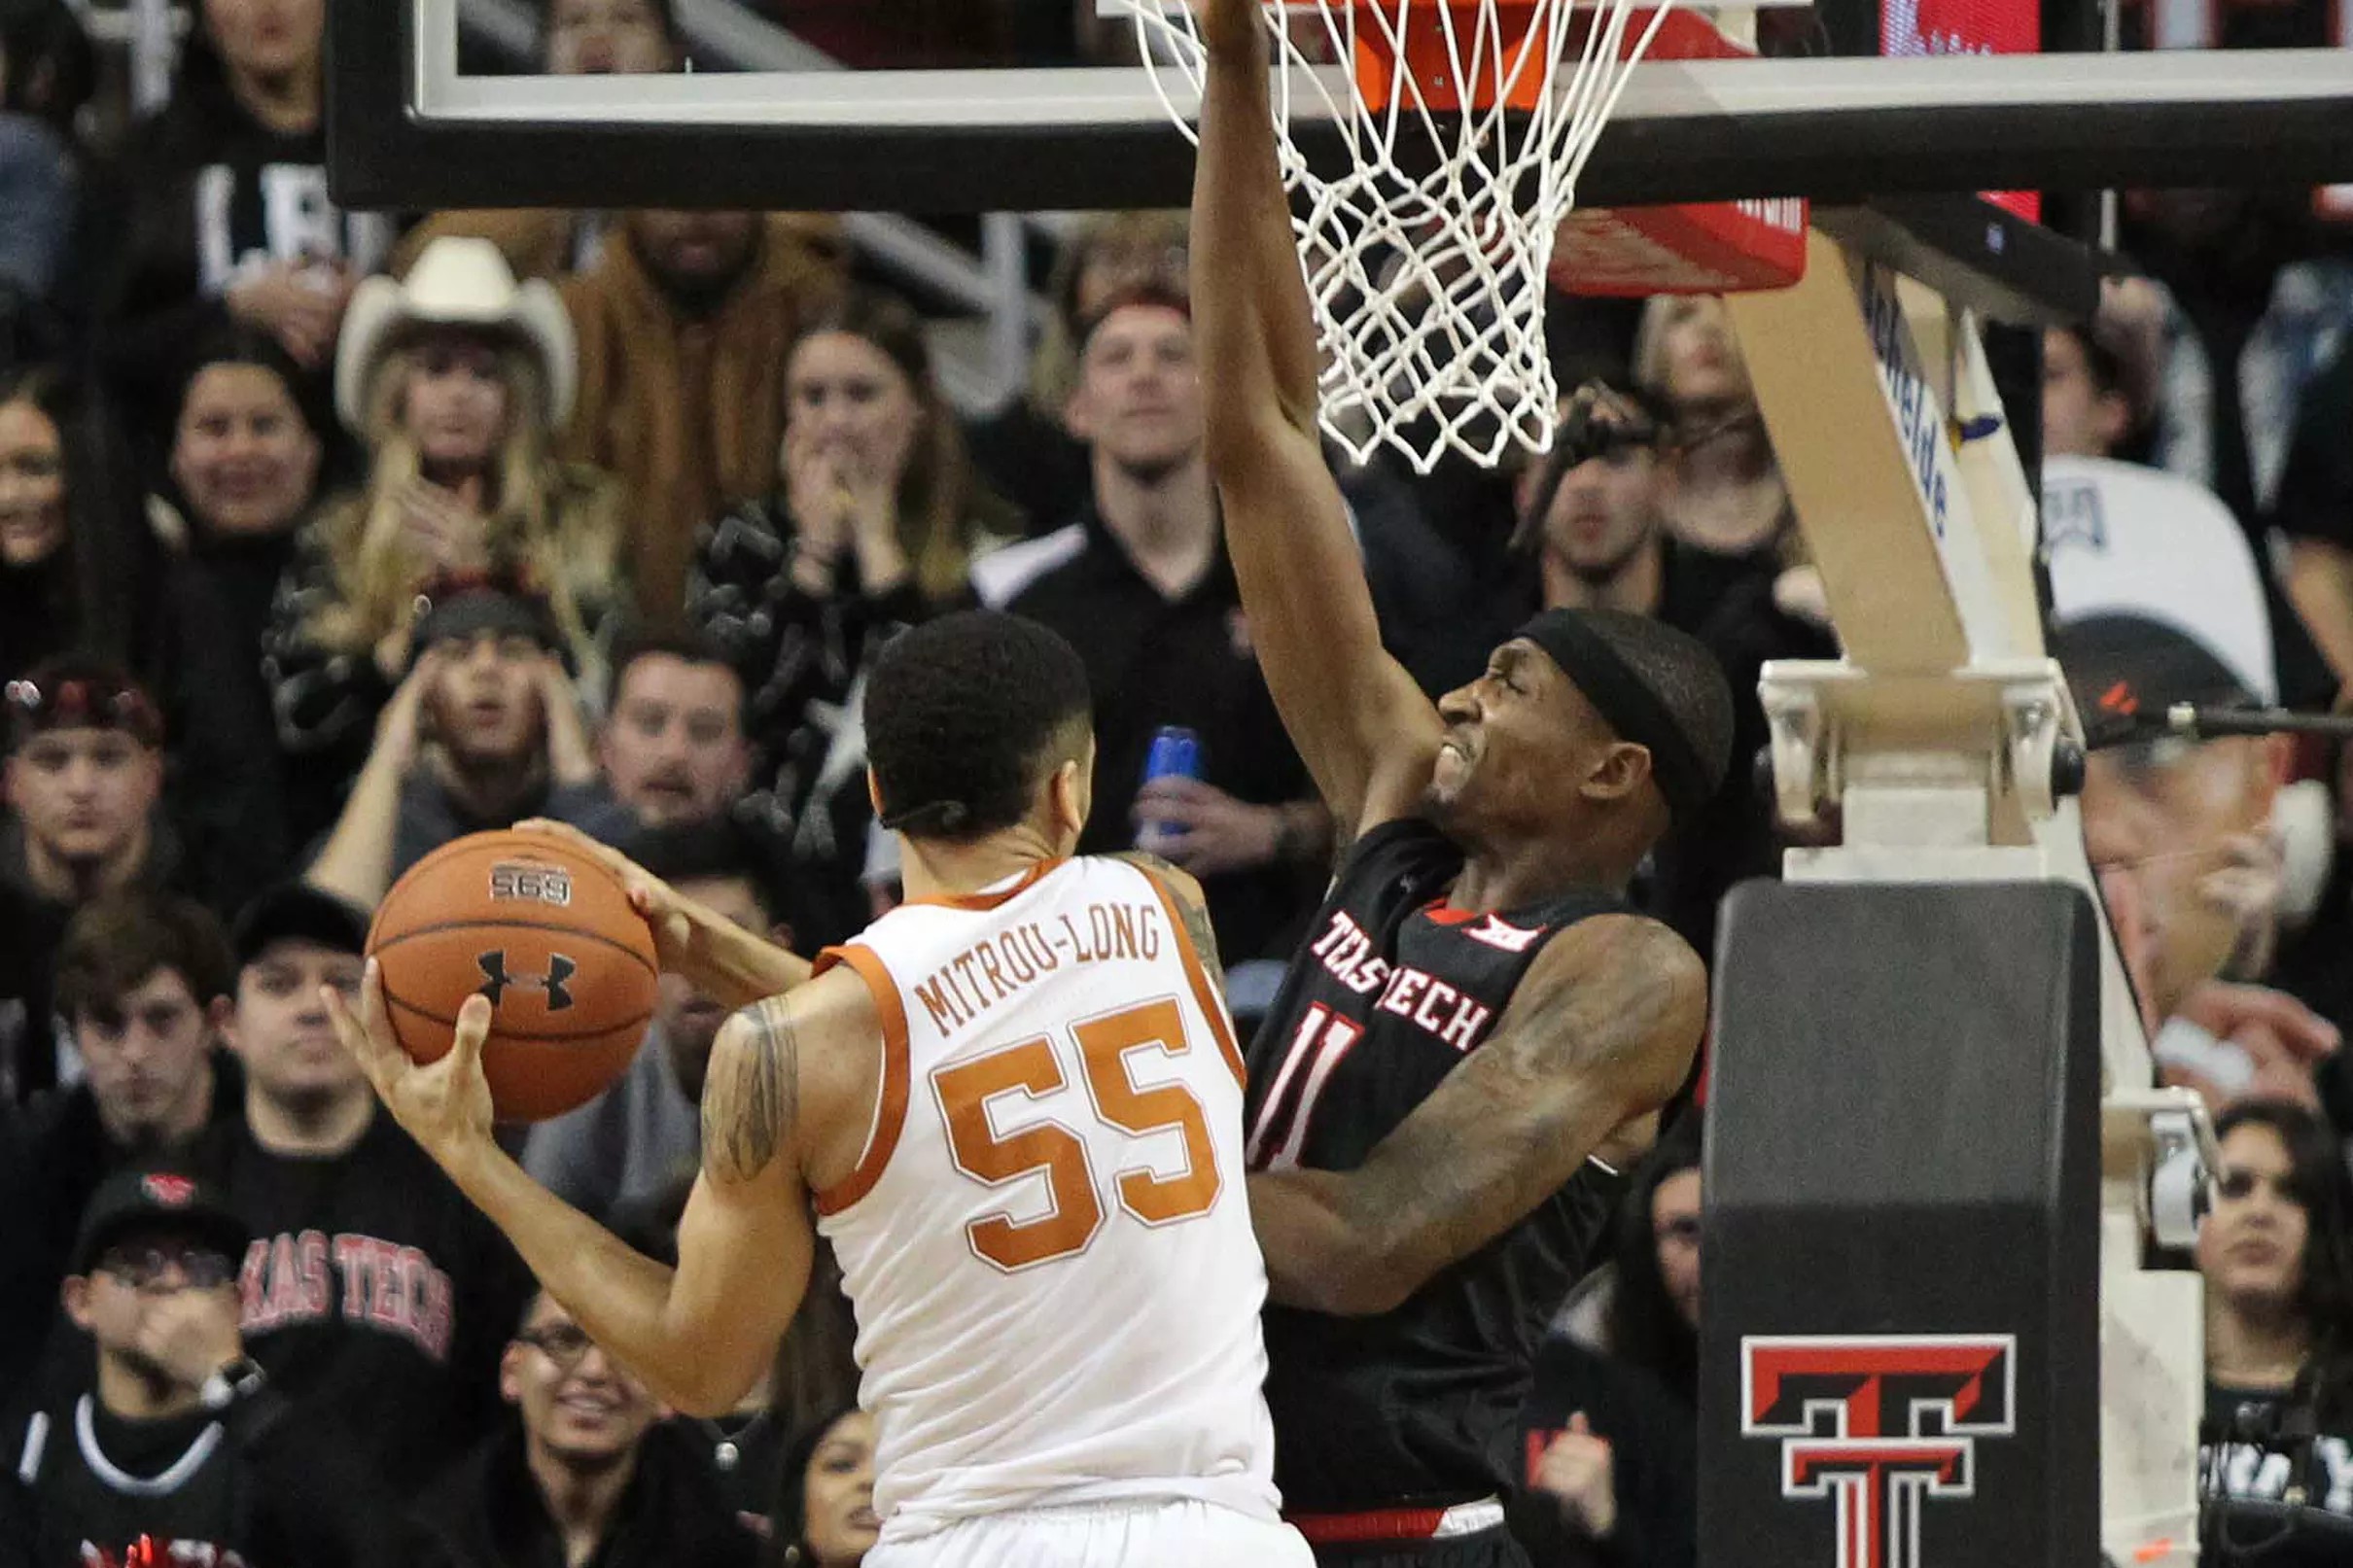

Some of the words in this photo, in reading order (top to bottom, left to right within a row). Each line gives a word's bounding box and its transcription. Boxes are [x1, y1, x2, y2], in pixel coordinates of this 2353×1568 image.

[914, 902, 1159, 1037] MITROU-LONG
[929, 993, 1224, 1274] 55
[1246, 999, 1366, 1172] 11
